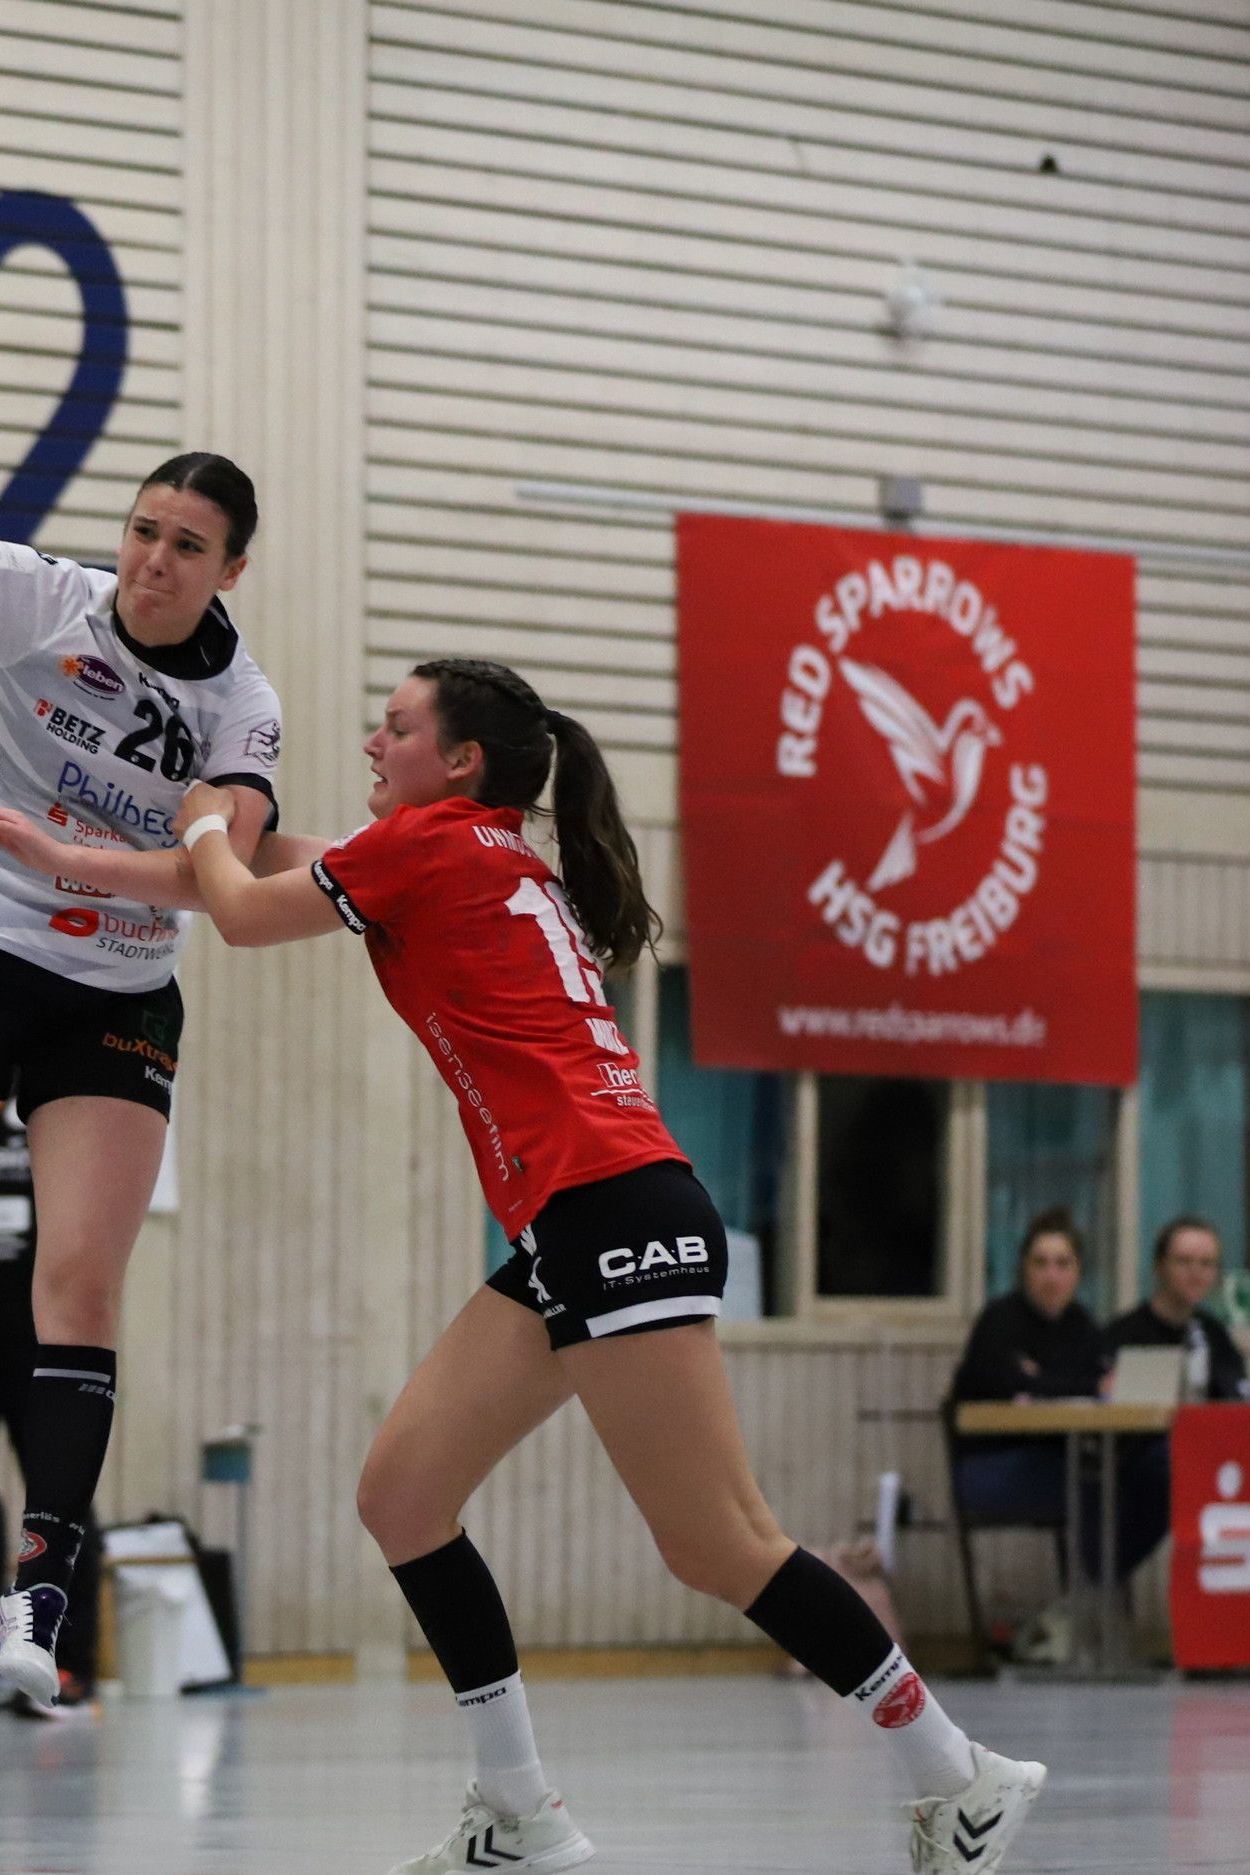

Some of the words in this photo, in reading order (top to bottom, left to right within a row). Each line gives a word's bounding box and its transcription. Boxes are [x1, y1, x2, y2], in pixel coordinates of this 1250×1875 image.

[82, 667, 124, 693] leben
[777, 643, 832, 778] RED
[815, 556, 1034, 709] SPARROWS
[46, 722, 99, 755] HOLDING
[50, 708, 107, 746] BETZ
[114, 699, 196, 782] 26
[807, 859, 899, 968] HSG
[904, 763, 1048, 977] FREIBURG
[337, 894, 366, 931] Kempa
[455, 1686, 507, 1707] empa
